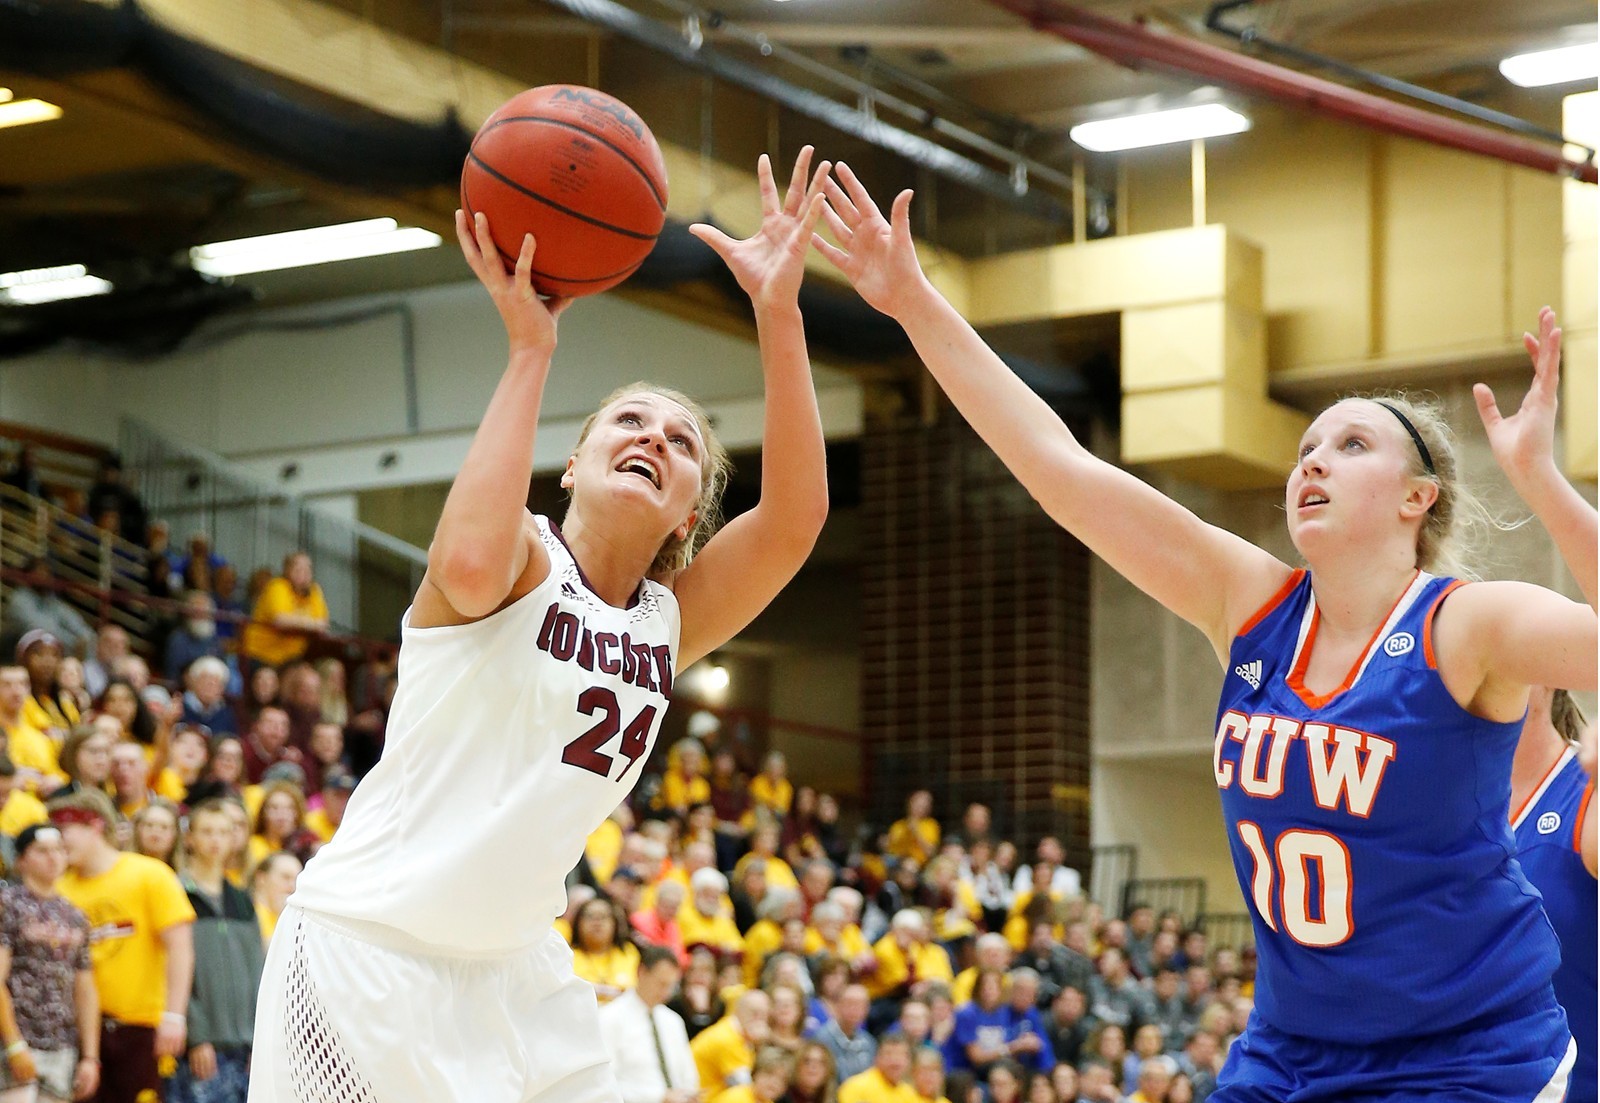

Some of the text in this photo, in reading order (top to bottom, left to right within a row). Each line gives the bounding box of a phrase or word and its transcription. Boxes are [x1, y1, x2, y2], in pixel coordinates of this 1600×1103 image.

[1235, 665, 1260, 690] adida
[561, 686, 657, 783] 24
[1213, 709, 1397, 819] CUW
[1237, 820, 1354, 947] 10
